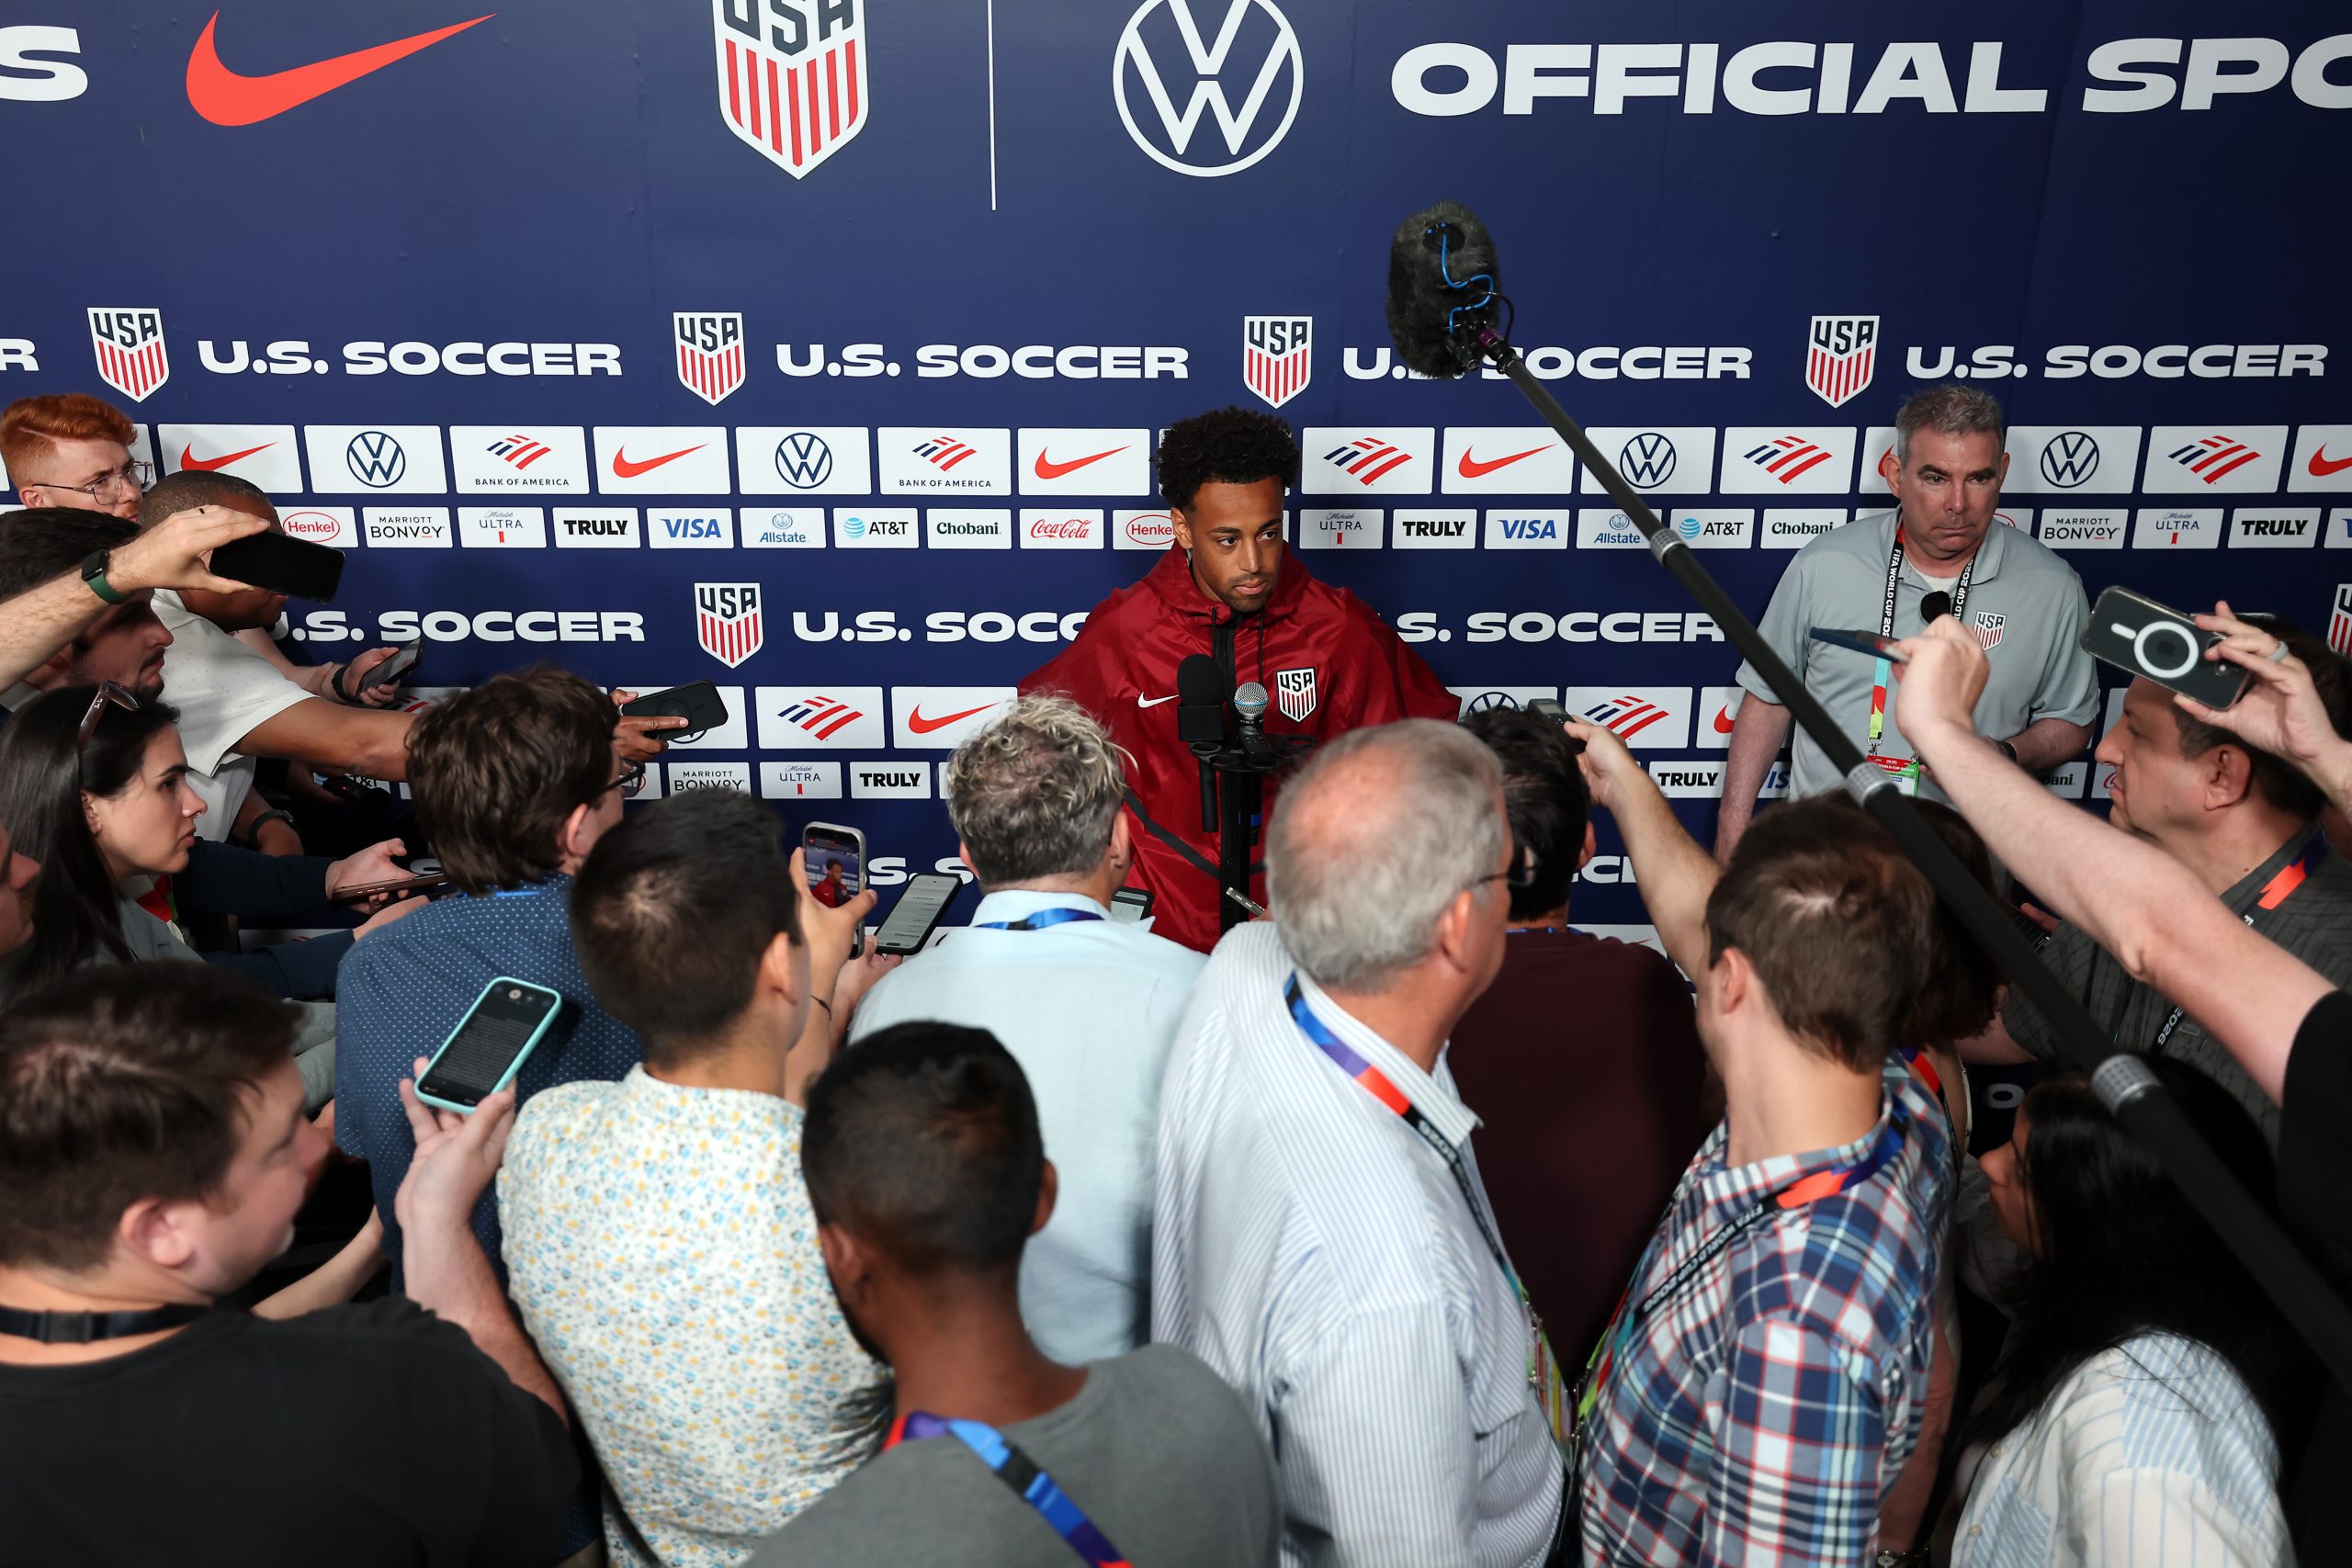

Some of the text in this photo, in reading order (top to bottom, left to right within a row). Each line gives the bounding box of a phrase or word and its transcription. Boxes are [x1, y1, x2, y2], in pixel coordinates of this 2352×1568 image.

[1391, 41, 2048, 116] OFFICIAL
[93, 311, 159, 347] USA
[678, 318, 738, 352] USA
[1250, 321, 1307, 355] USA
[1815, 321, 1874, 355] USA
[198, 340, 623, 376] U.S. SOCCER
[776, 344, 1188, 378] U.S. SOCCER
[1906, 344, 2329, 379] U.S. SOCCER
[288, 521, 336, 533] Henkel
[479, 519, 524, 529] ULTRA
[563, 520, 628, 536] TRULY
[659, 519, 722, 538] VISA
[868, 522, 909, 536] AT&T
[936, 522, 999, 535] Chobani
[1319, 521, 1363, 530] ULTRA
[1402, 521, 1466, 536] TRULY
[1498, 520, 1556, 539] VISA
[1703, 523, 1744, 536] AT&T
[1771, 522, 1834, 535] Chobani
[2155, 520, 2199, 530] ULTRA
[2241, 520, 2309, 536] TRULY
[370, 526, 445, 539] BONVOY
[760, 532, 807, 543] Allstate
[1594, 533, 1640, 544] Allstate
[2044, 527, 2118, 539] BONVOY
[1891, 548, 1901, 567] FIFA
[1887, 568, 1897, 599] WORLD
[699, 588, 756, 619] USA
[1956, 588, 1966, 604] CUP
[378, 611, 645, 641] SOCCER
[793, 611, 1091, 643] U.S. SOCC
[1466, 612, 1725, 642] SOCCER
[1883, 617, 1891, 637] 20
[1978, 613, 2004, 629] USA
[1280, 671, 1313, 693] USA
[779, 773, 821, 782] ULTRA
[859, 773, 921, 787] TRULY
[1657, 773, 1719, 787] TRULY
[1767, 772, 1790, 789] IS
